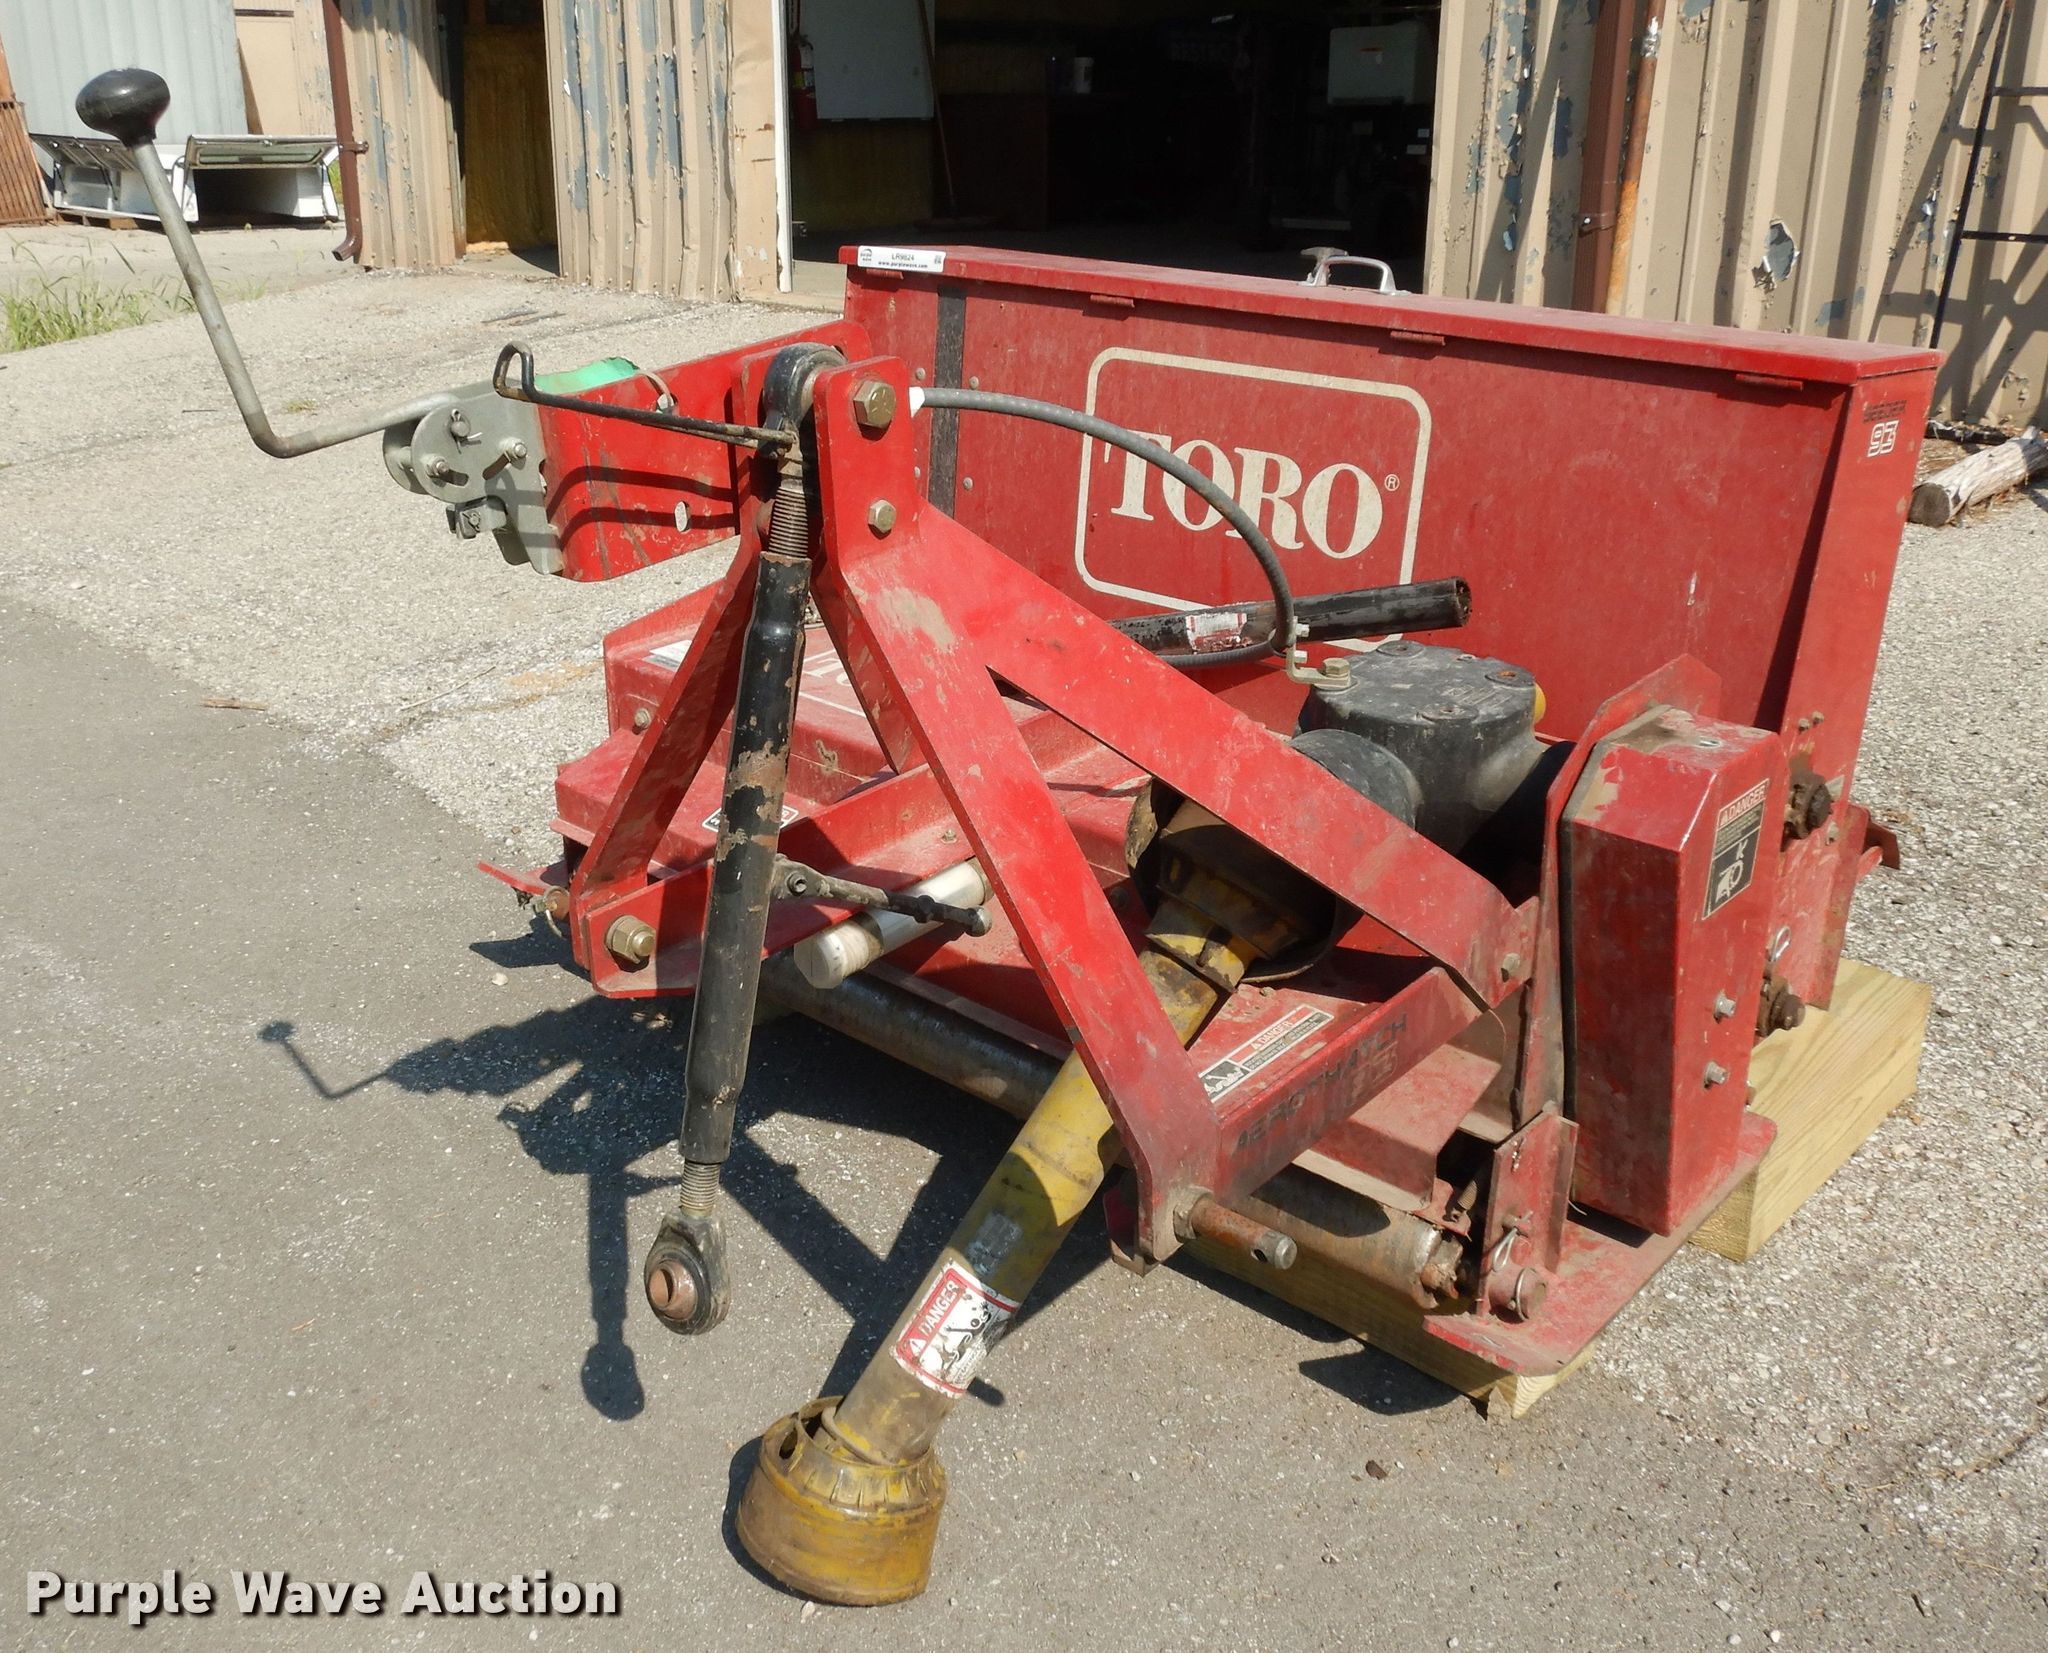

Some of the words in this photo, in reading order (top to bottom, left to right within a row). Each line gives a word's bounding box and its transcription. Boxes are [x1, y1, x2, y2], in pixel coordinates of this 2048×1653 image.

[1104, 429, 1384, 559] TORO
[1728, 784, 1766, 819] DANGER
[1261, 1020, 1295, 1044] DANGER
[920, 1280, 959, 1338] DANGER
